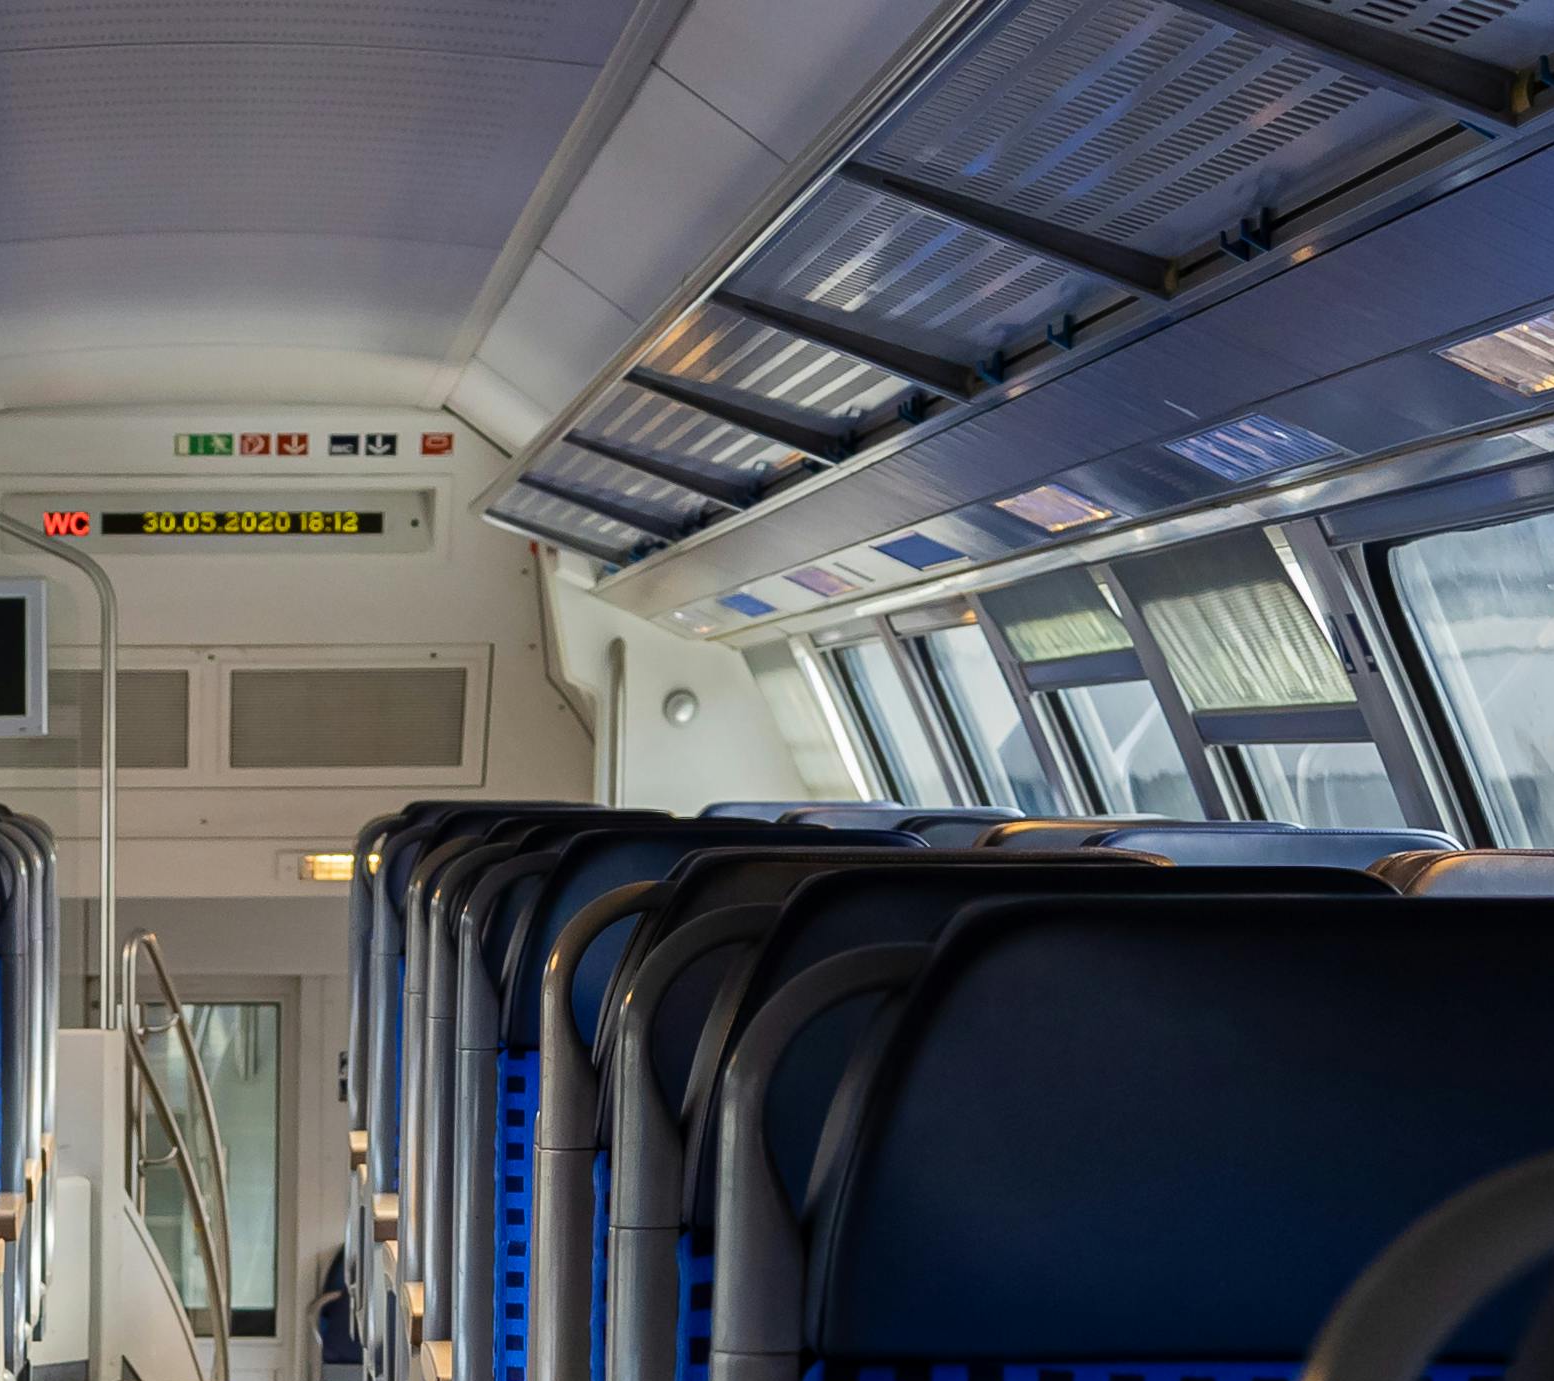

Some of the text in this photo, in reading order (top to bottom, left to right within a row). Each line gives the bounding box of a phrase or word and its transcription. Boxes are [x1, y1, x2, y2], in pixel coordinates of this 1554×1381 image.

[43, 511, 90, 537] WC
[143, 511, 358, 533] 30.05.2020 18:12
